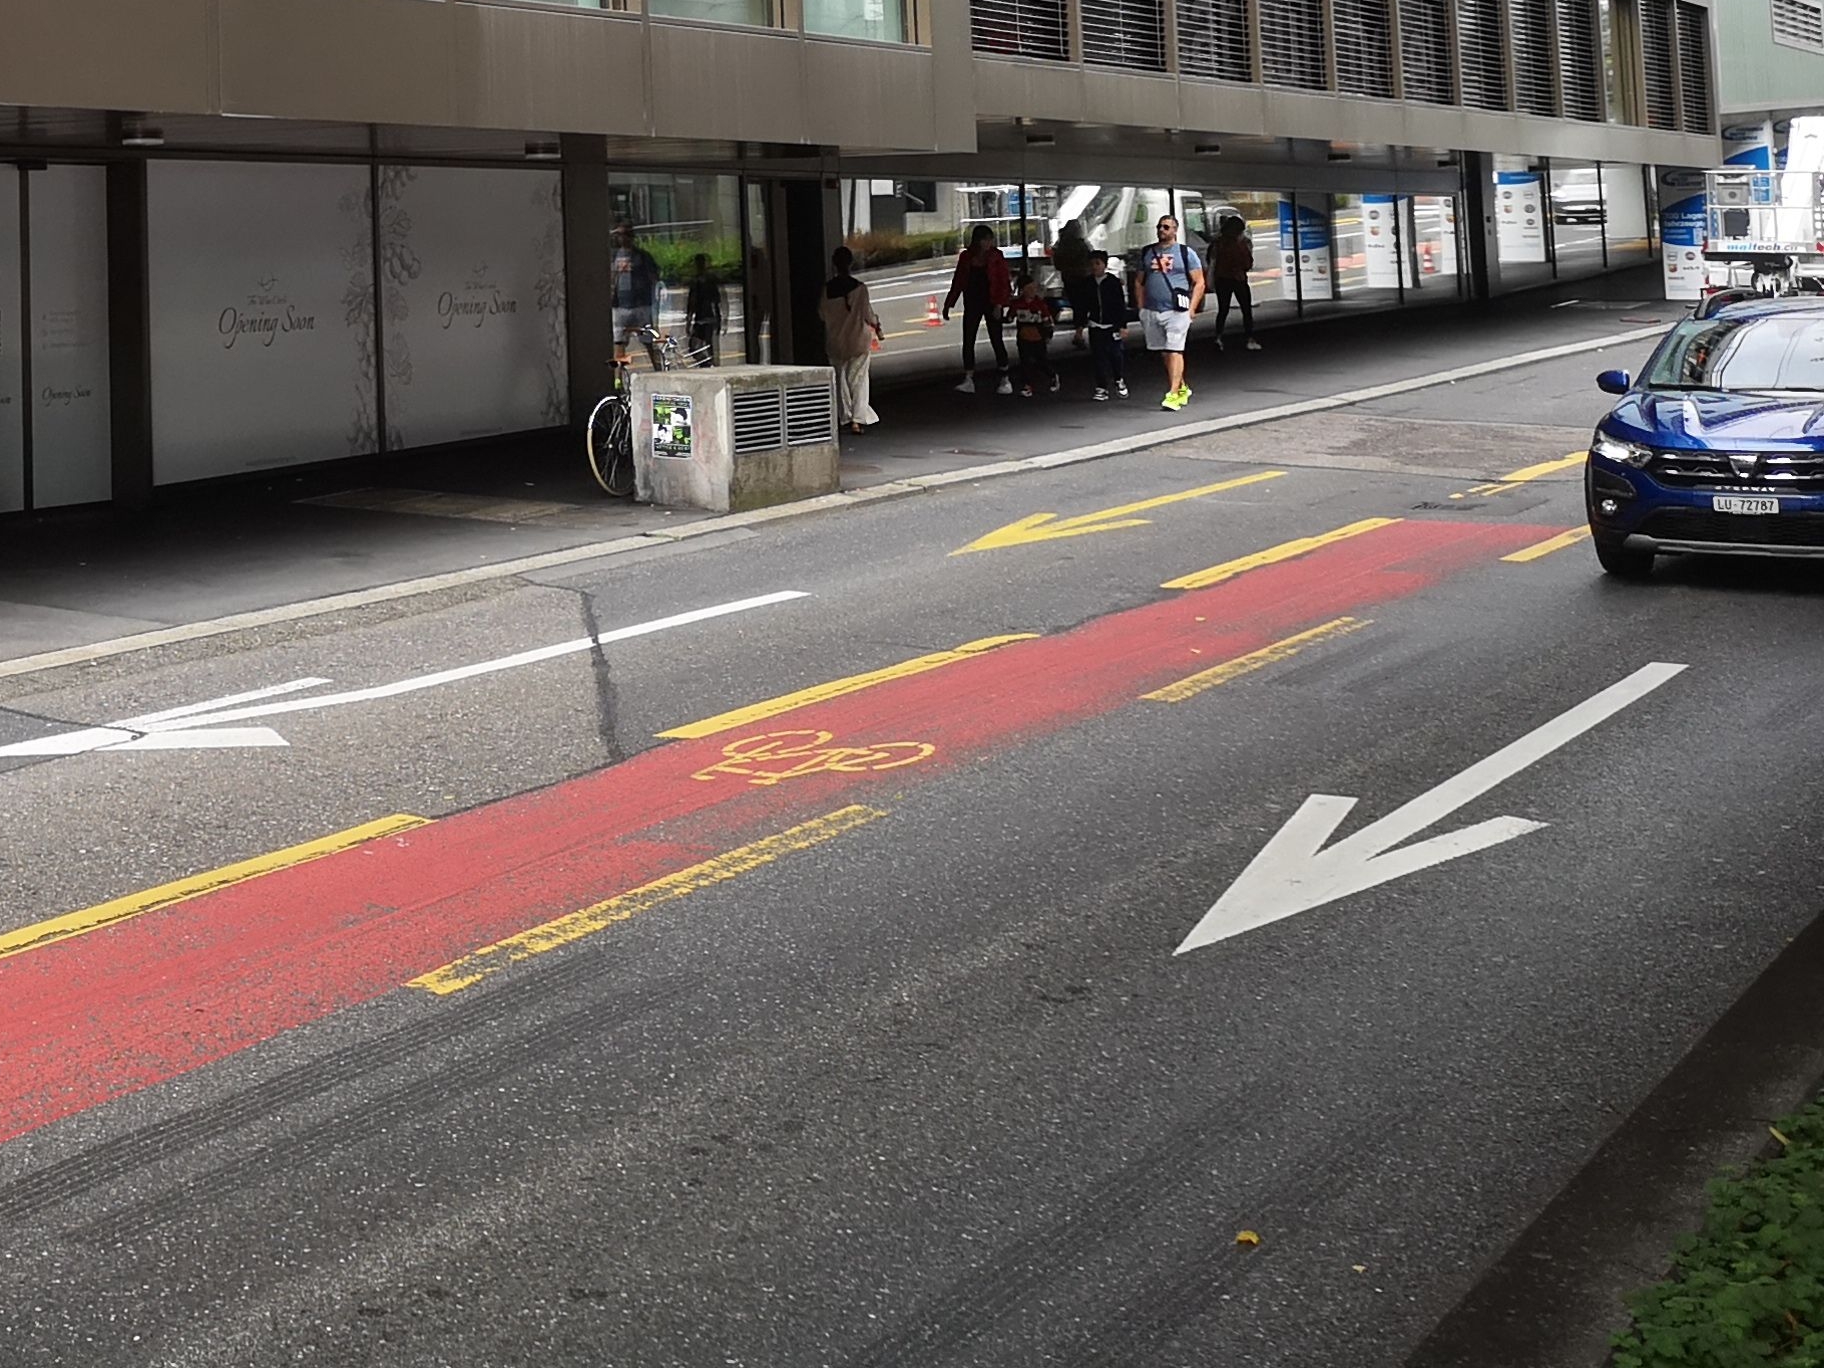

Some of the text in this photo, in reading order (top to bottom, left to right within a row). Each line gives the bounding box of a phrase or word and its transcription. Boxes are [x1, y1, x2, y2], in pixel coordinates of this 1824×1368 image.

[219, 304, 314, 349] Opening Soon
[438, 291, 487, 330] Opening
